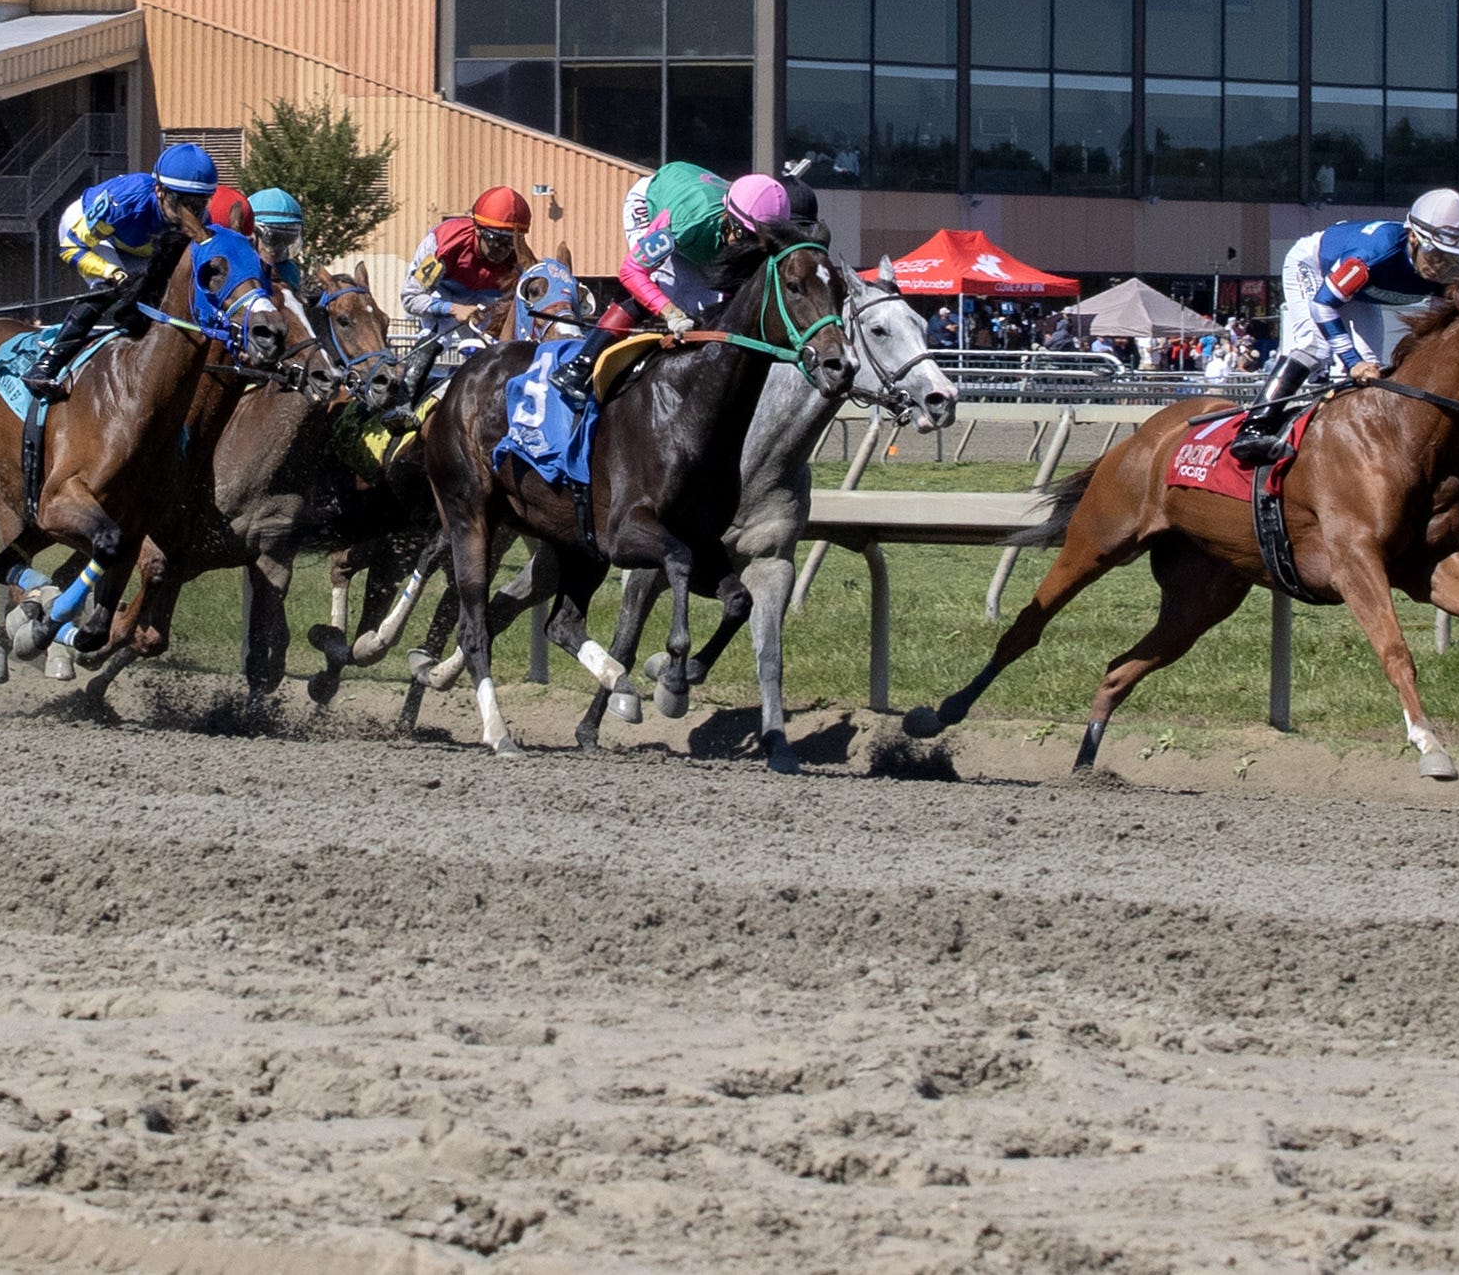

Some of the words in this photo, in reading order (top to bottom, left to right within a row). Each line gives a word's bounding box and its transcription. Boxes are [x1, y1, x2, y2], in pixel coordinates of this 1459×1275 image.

[87, 199, 106, 221] 9
[644, 233, 670, 258] 3
[421, 261, 436, 281] 4
[1337, 265, 1360, 287] 1
